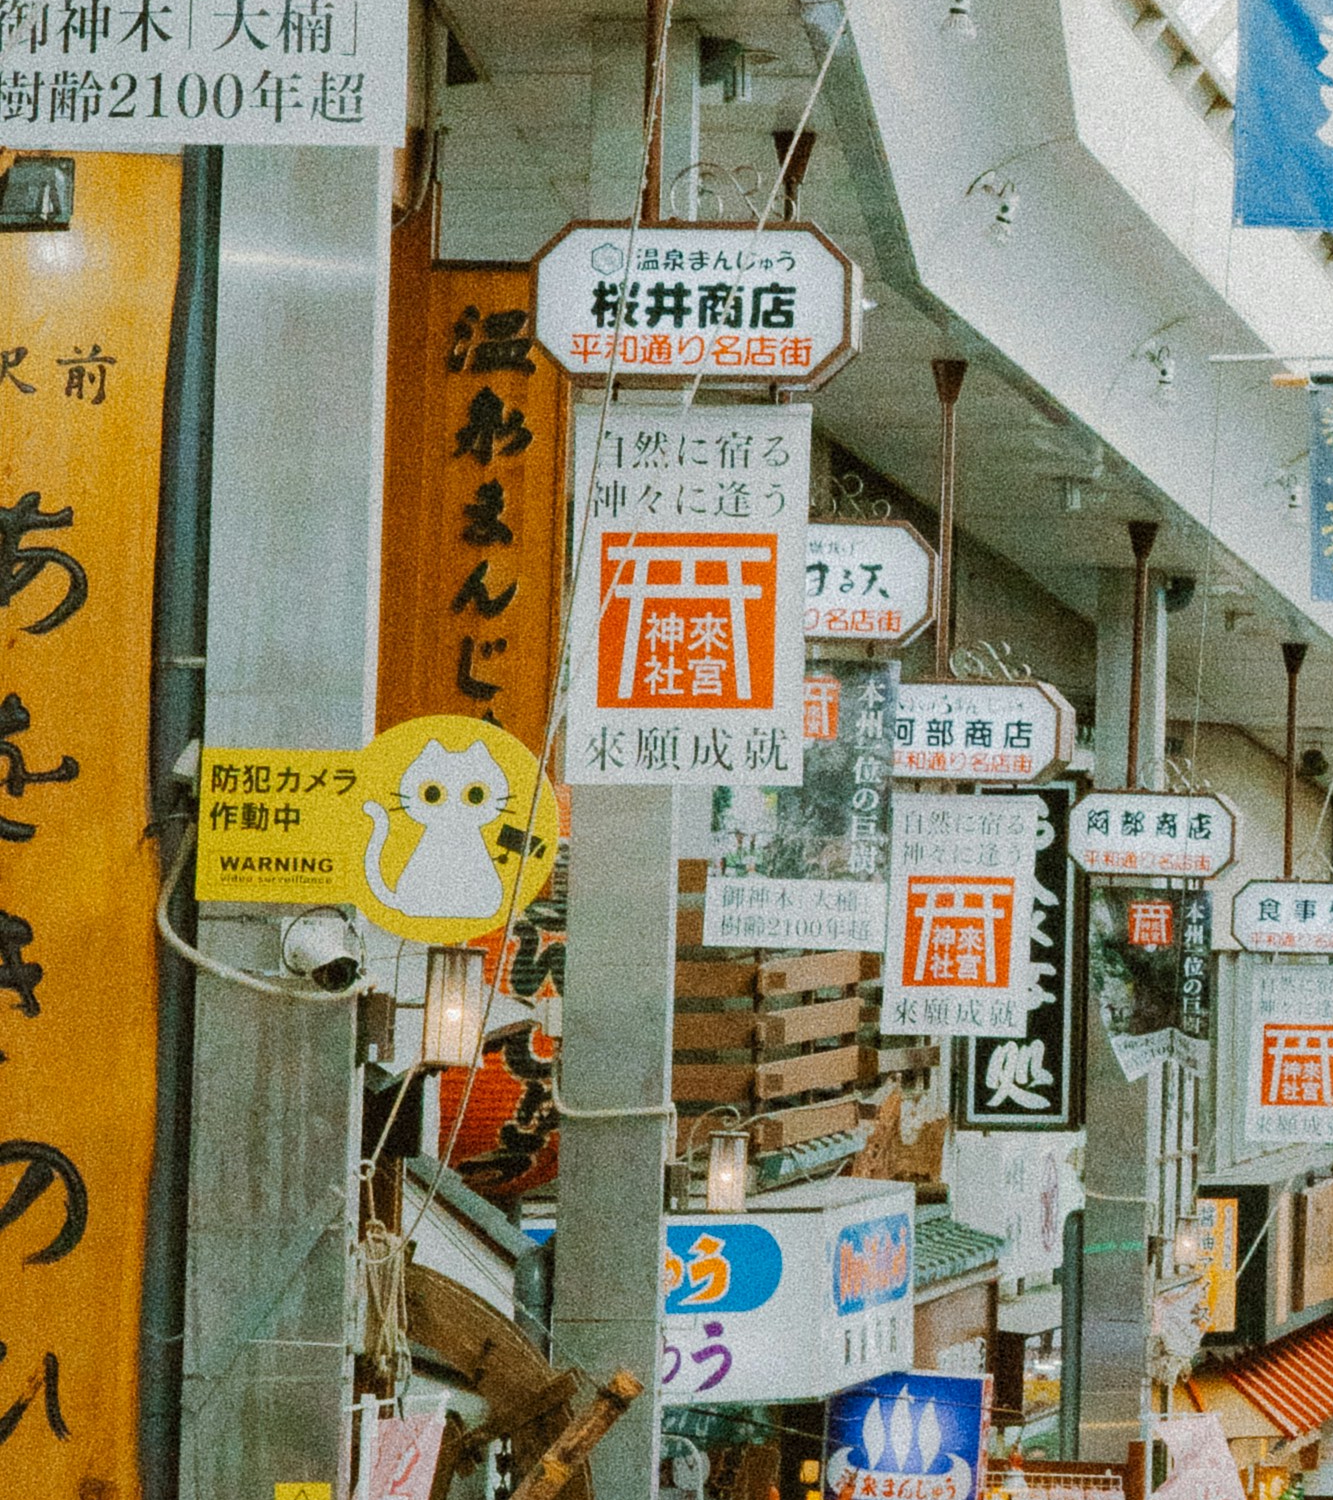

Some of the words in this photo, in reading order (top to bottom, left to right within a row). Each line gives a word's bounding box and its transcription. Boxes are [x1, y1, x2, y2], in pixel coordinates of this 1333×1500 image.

[636, 246, 798, 273] 温泉まんじゅう
[590, 280, 798, 330] 桜井商店
[569, 331, 814, 368] 平和通り名店街
[594, 428, 793, 472] 自然に宿る
[446, 303, 538, 728] 温泉まんじ
[211, 763, 358, 796] 防犯カメラ
[209, 801, 301, 833] 作動中
[219, 856, 334, 873] WARNING
